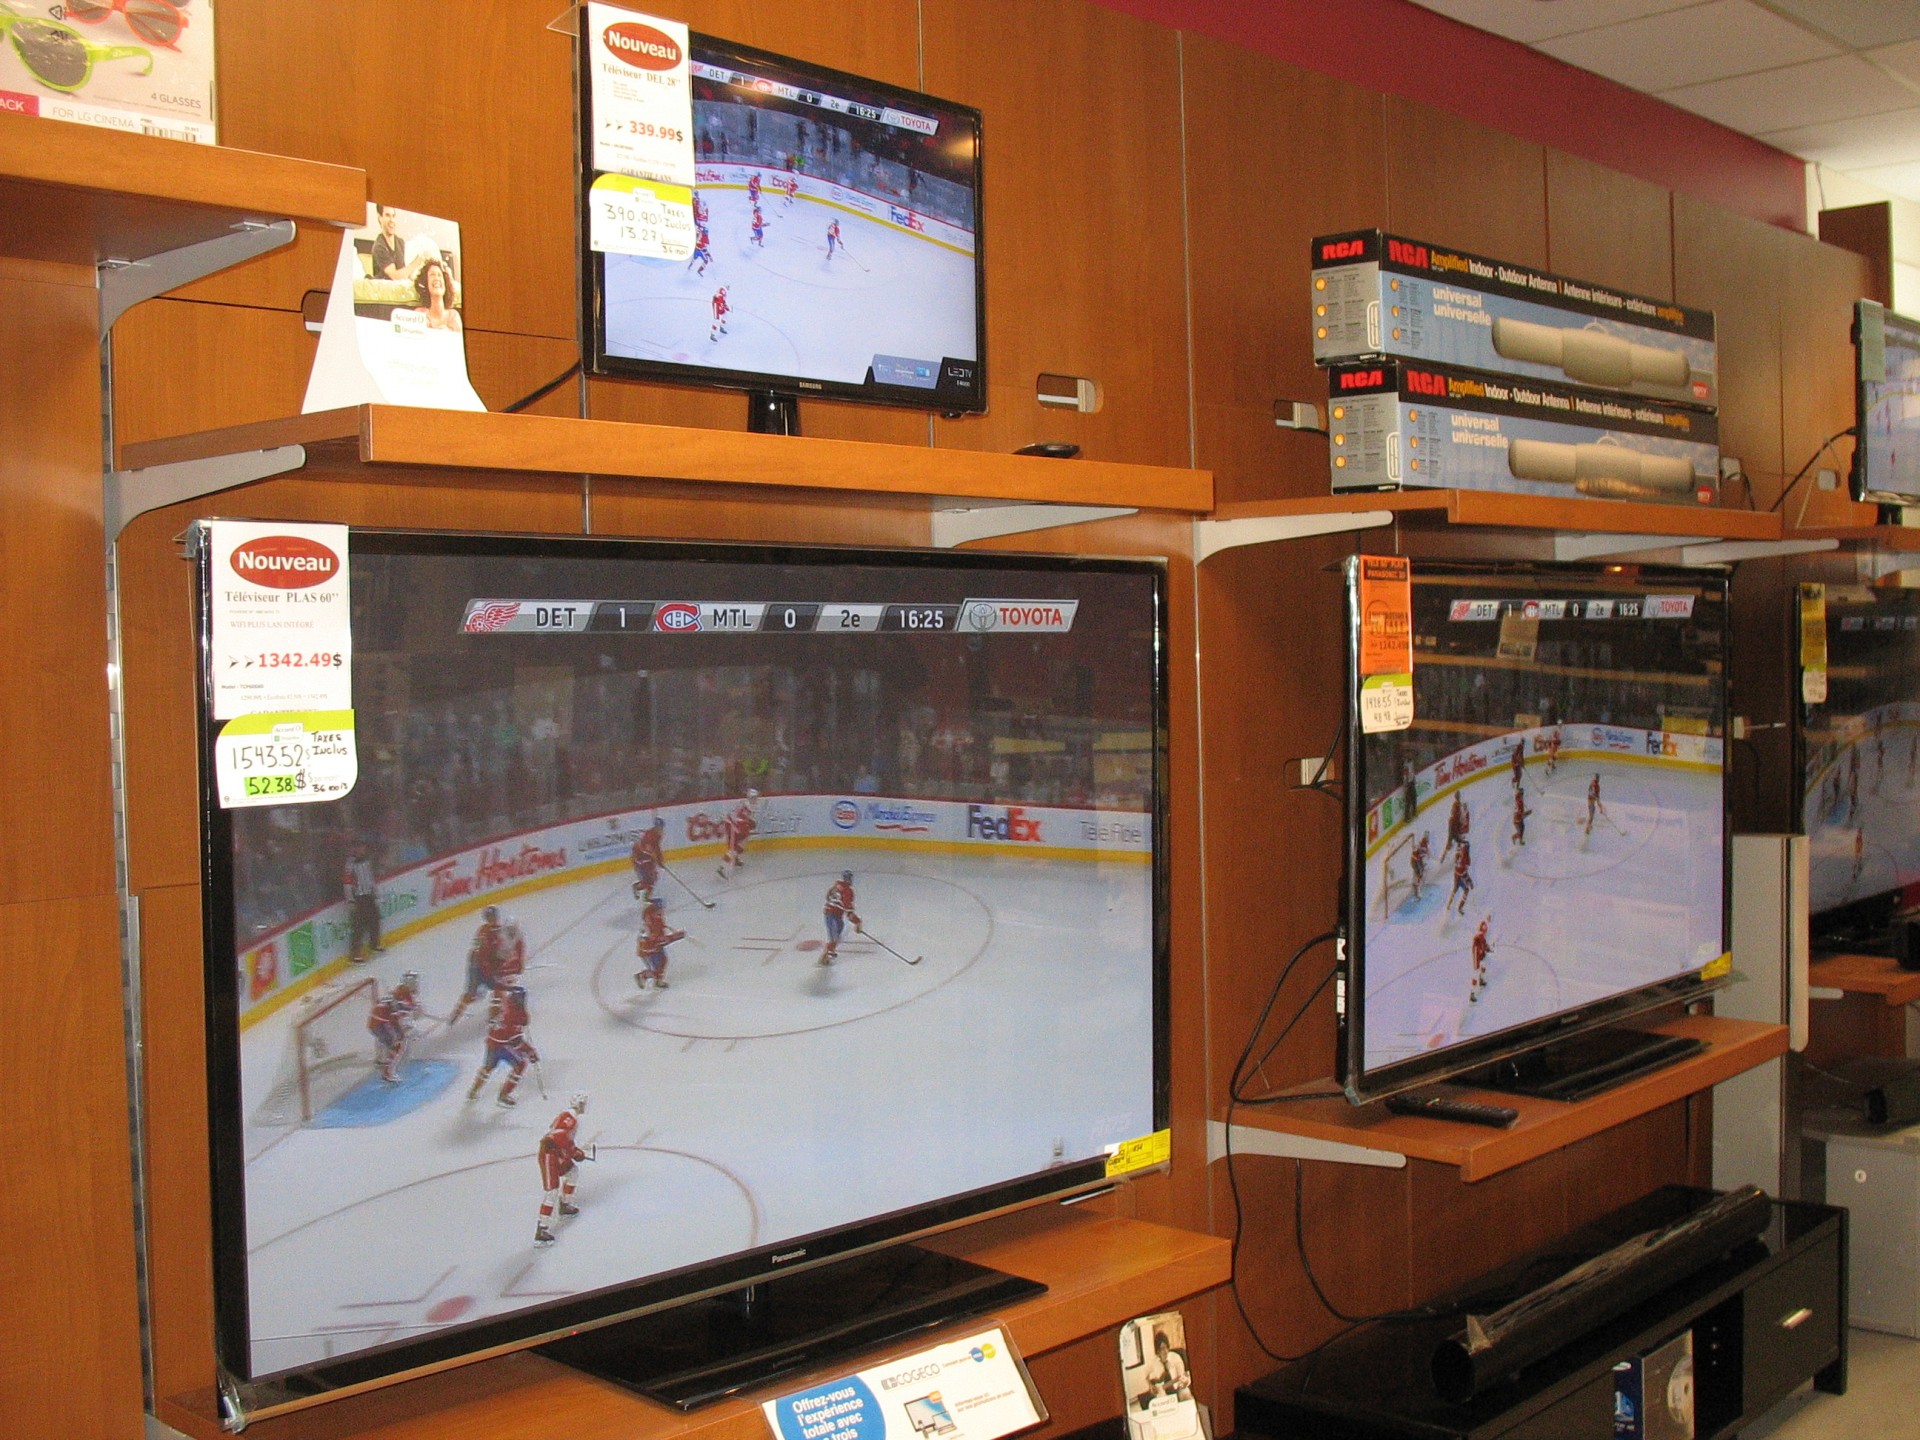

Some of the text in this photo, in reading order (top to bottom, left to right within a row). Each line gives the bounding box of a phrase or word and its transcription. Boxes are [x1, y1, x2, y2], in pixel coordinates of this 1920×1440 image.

[608, 30, 677, 60] Nouveau
[602, 63, 642, 79] Téléviseur
[647, 72, 665, 84] DEL
[160, 94, 201, 109] GLASSES
[709, 69, 725, 81] DET
[777, 86, 794, 98] MTL
[856, 105, 876, 119] 16:25
[901, 115, 931, 131] TOYOTA
[52, 106, 74, 118] FOR
[78, 112, 91, 122] LG
[94, 113, 134, 128] CINEMA
[629, 120, 683, 143] 339.99$
[890, 206, 925, 232] FedEx
[1322, 240, 1364, 260] RCA
[1388, 239, 1429, 269] RCA
[1469, 259, 1493, 278] Indoor
[1499, 266, 1527, 284] Outdoor
[1433, 286, 1482, 308] universal
[1433, 303, 1492, 326] universelle
[1340, 370, 1384, 389] RCA
[1407, 370, 1447, 396] RCA
[1485, 383, 1508, 400] Indoor
[1513, 387, 1541, 406] Outdoor
[1451, 412, 1500, 431] universal
[1452, 430, 1509, 449] universelle
[238, 551, 331, 571] Nouveau
[225, 591, 280, 603] Téléviseur
[286, 592, 317, 603] PLAS
[536, 607, 1063, 629] DET 1 MTL 0 2e 16:25 TOYOTA
[1477, 605, 1493, 617] DET
[1544, 605, 1560, 616] MTL
[1619, 602, 1638, 616] 16:25
[1660, 600, 1688, 613] TOYOTA
[258, 652, 342, 669] 1342.49$
[967, 805, 1044, 842] FedEx
[896, 1363, 940, 1386] COGECO
[792, 1386, 856, 1414] Offrez-vous
[797, 1398, 864, 1426] l'expérience
[803, 1412, 863, 1440] totale avec
